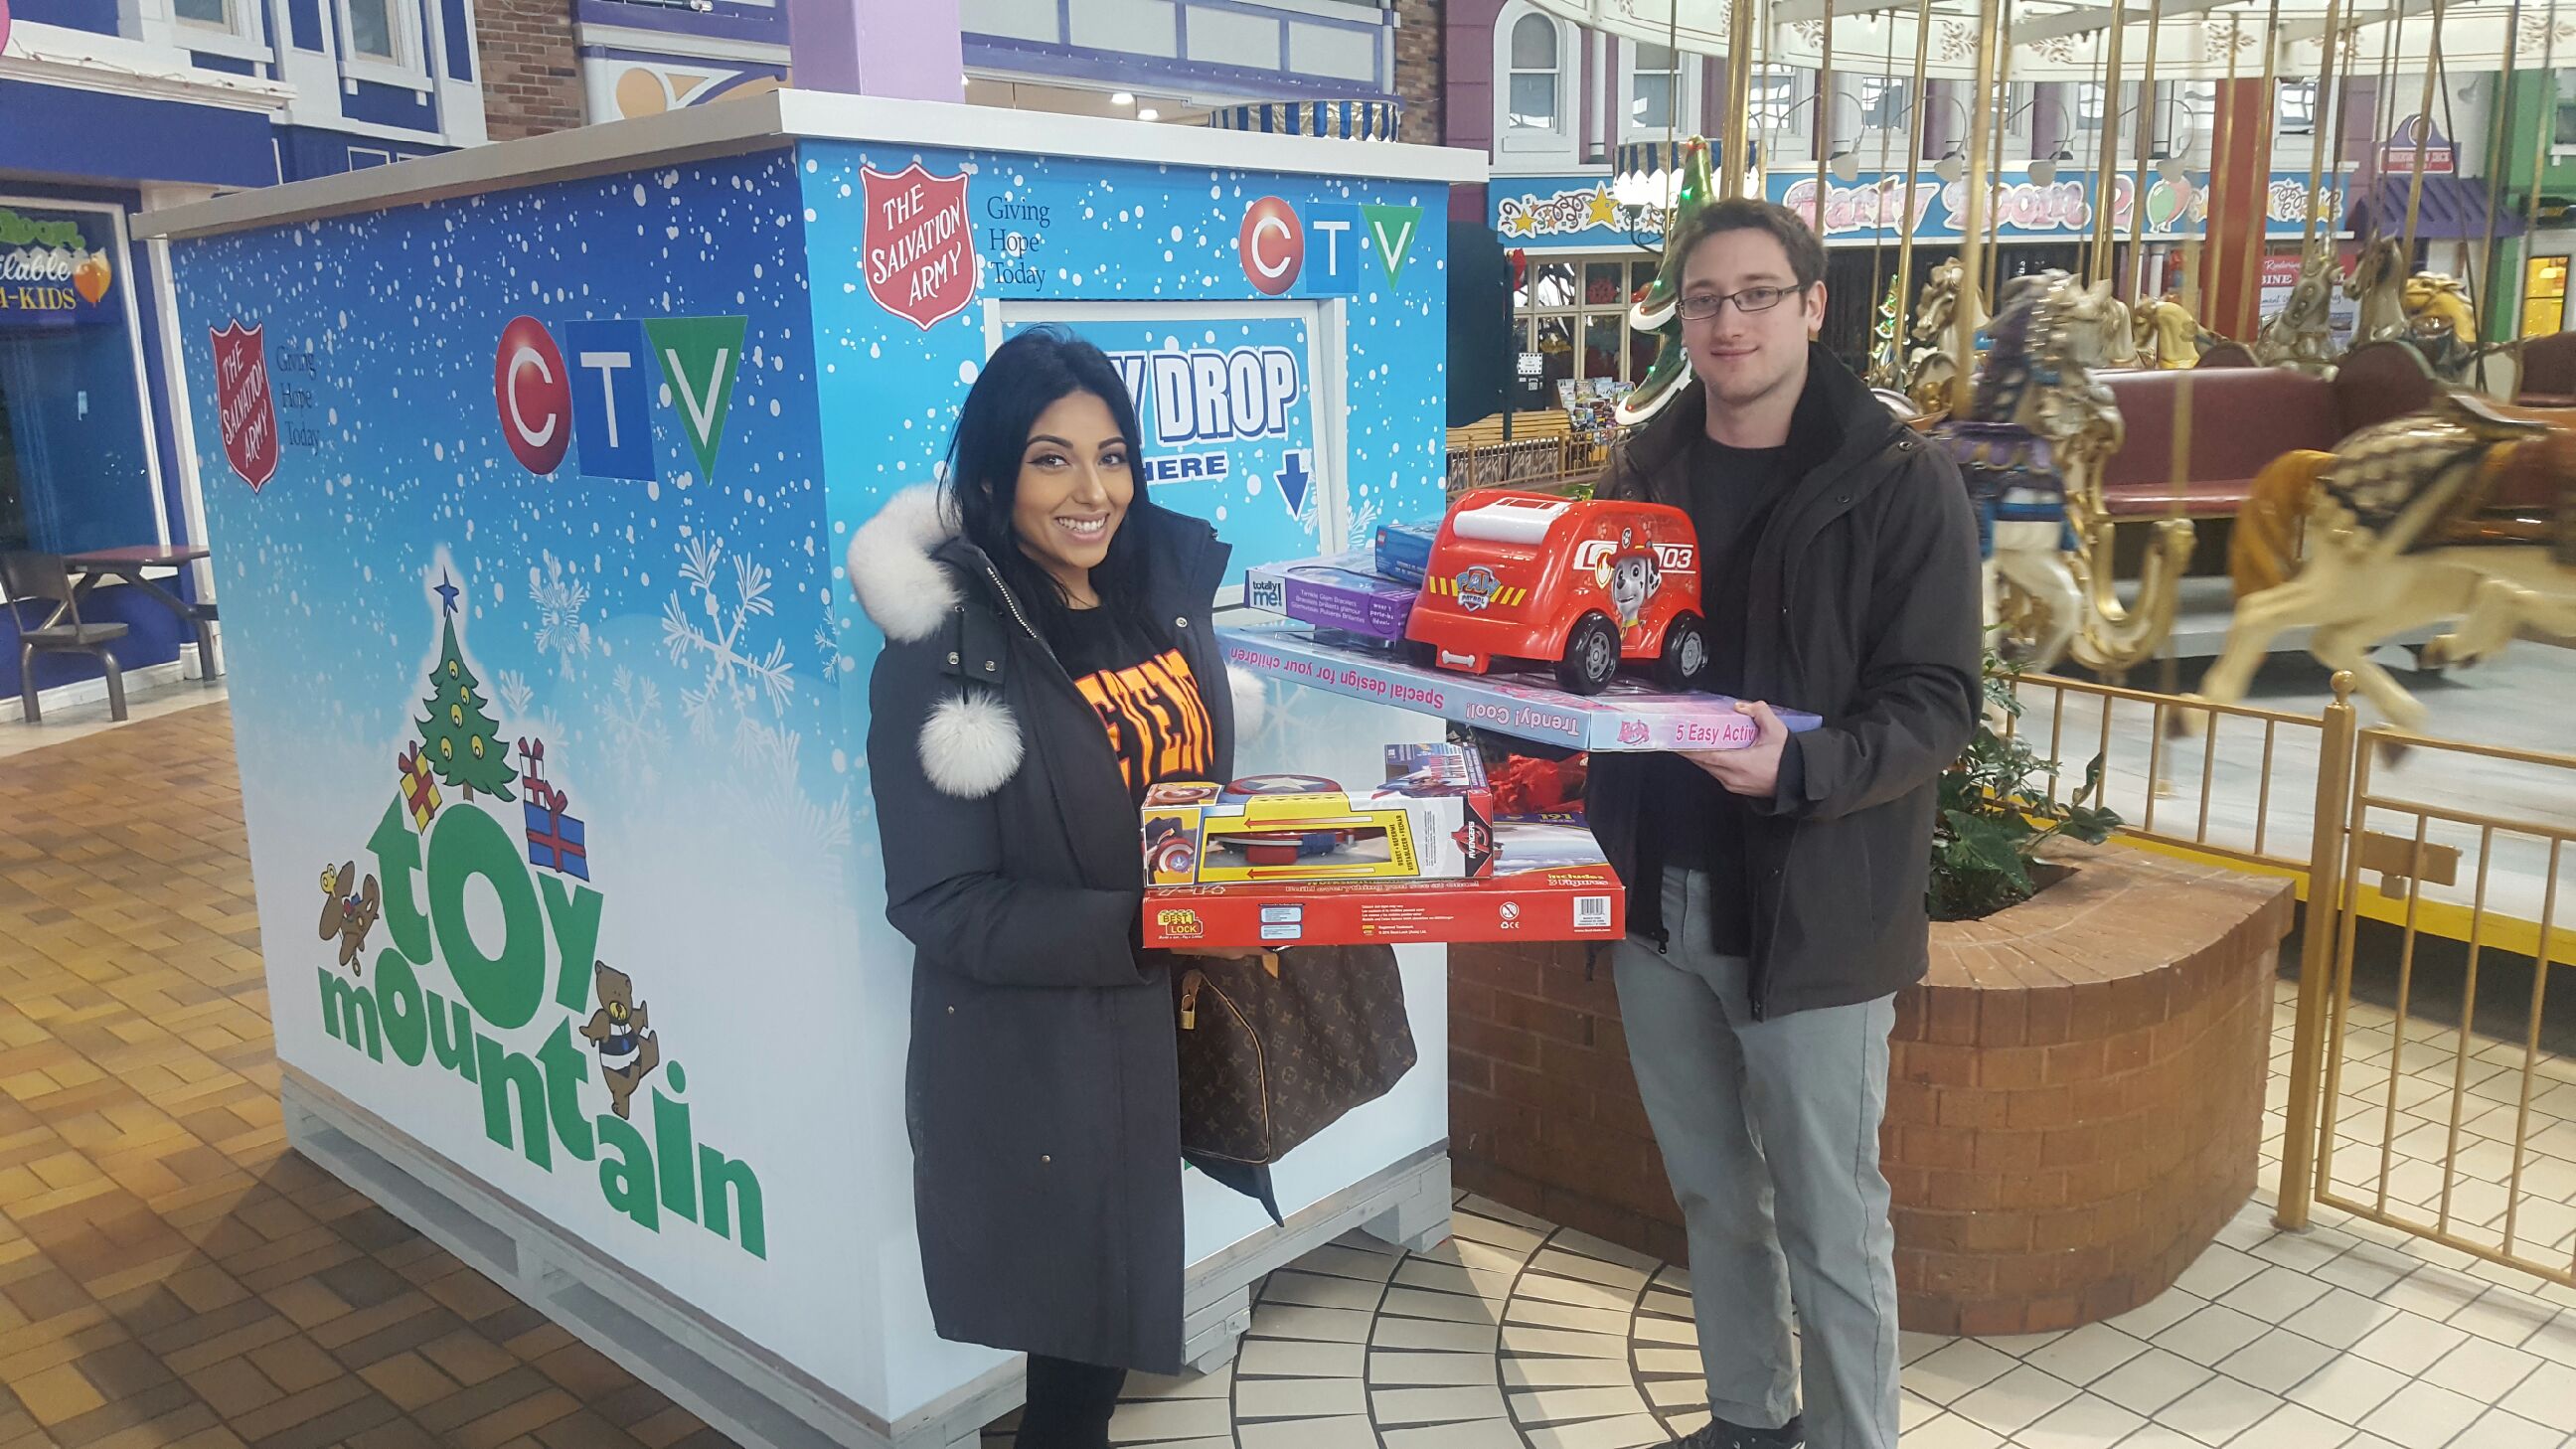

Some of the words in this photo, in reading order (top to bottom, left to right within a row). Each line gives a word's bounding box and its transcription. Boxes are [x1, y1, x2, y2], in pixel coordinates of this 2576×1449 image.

[883, 184, 924, 231] THE
[987, 196, 1049, 228] Giving
[872, 197, 961, 284] SALVATION
[989, 229, 1040, 258] Hope
[1249, 213, 1413, 280] CTV
[908, 242, 962, 307] ARMY
[991, 261, 1046, 291] Today
[222, 340, 244, 390] THE
[277, 346, 317, 381] Giving
[222, 350, 264, 445] SALVATION
[280, 383, 313, 416] Hope
[504, 341, 732, 454] CTV
[1151, 349, 1299, 443] DROP
[245, 399, 268, 469] ARMY
[284, 421, 320, 456] Today
[1663, 548, 1692, 569] 03
[1252, 580, 1278, 592] totally
[1253, 582, 1283, 606] me!
[1456, 571, 1502, 595] PAW
[1230, 647, 1281, 670] children
[1283, 660, 1313, 676] your
[1316, 667, 1336, 684] for
[1340, 670, 1386, 696] design
[1389, 684, 1444, 709] Special
[1466, 703, 1510, 724] Cool!
[1515, 707, 1579, 737] Trendy!
[1676, 724, 1685, 741] 5
[1689, 723, 1719, 744] Easy
[366, 790, 604, 1030] toy
[1163, 914, 1189, 923] BEST
[318, 947, 767, 1261] mountain
